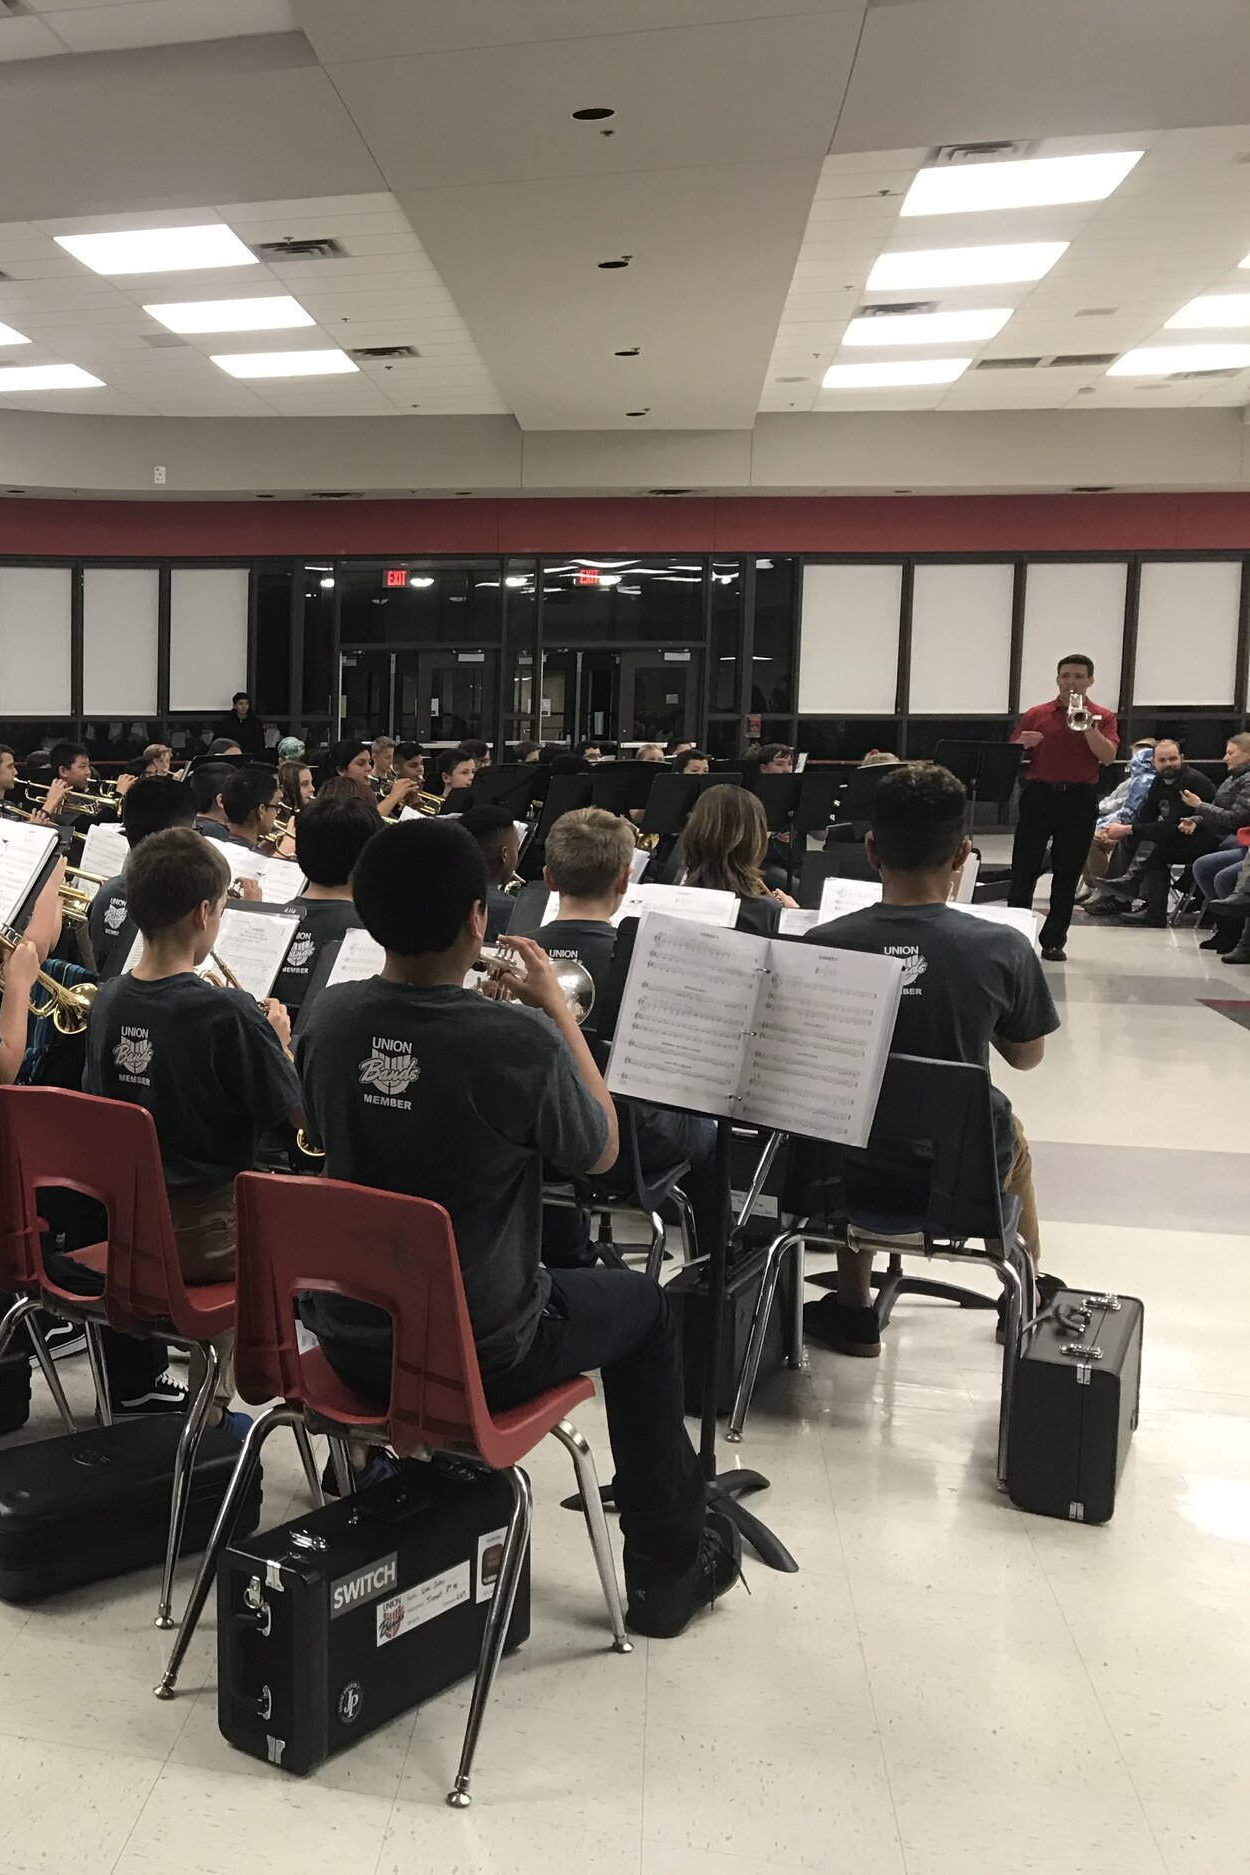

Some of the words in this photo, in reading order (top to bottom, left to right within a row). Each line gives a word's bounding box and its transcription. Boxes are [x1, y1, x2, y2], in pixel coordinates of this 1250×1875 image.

[387, 570, 406, 586] EXIT
[579, 569, 598, 584] EXIT
[549, 949, 578, 959] UNION
[883, 945, 919, 955] UNION
[902, 987, 922, 996] BER
[121, 1025, 149, 1039] UNION
[372, 1036, 413, 1054] UNION
[358, 1057, 421, 1083] Bands
[118, 1073, 151, 1087] MEMBER
[363, 1093, 412, 1111] MEMBER
[333, 1561, 396, 1610] SWITCH
